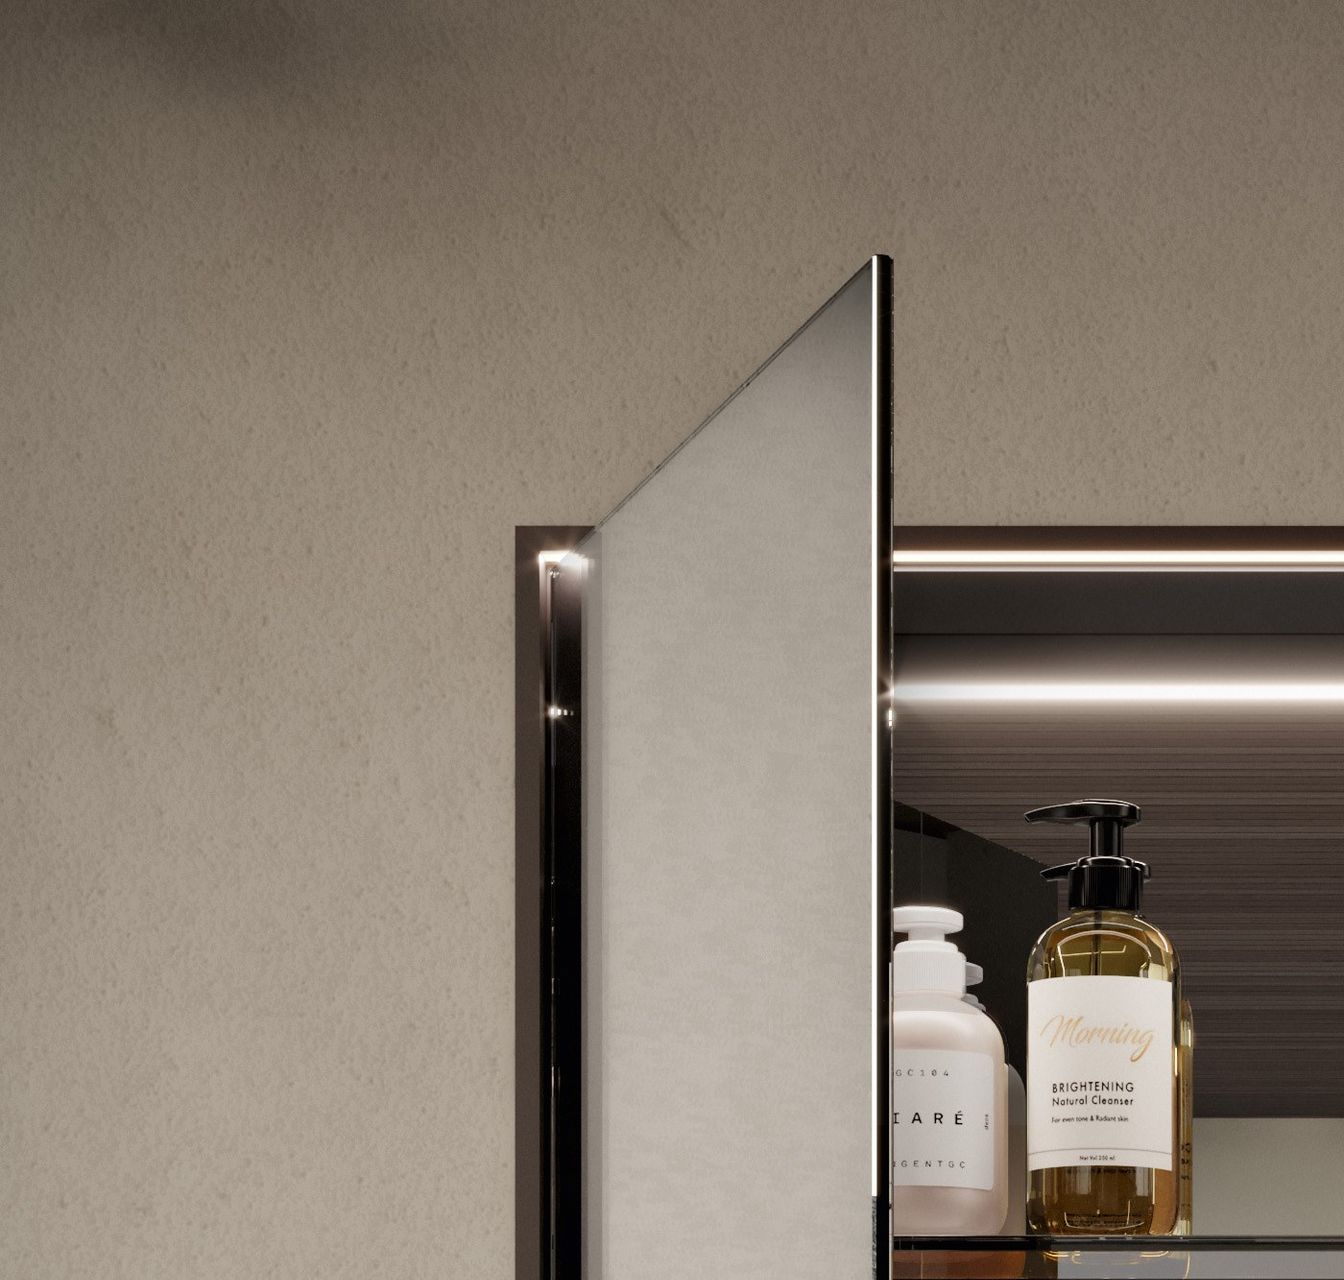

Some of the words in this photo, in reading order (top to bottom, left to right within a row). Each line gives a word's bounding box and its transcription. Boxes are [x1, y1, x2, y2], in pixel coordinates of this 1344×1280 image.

[1040, 1014, 1155, 1062] Morning
[895, 1068, 949, 1077] GC104
[1052, 1081, 1135, 1094] BRIGHTENING
[1052, 1096, 1088, 1106] Natural
[1091, 1095, 1134, 1106] Cleanser
[893, 1110, 963, 1125] IARÉ
[1096, 1114, 1116, 1122] Radiant
